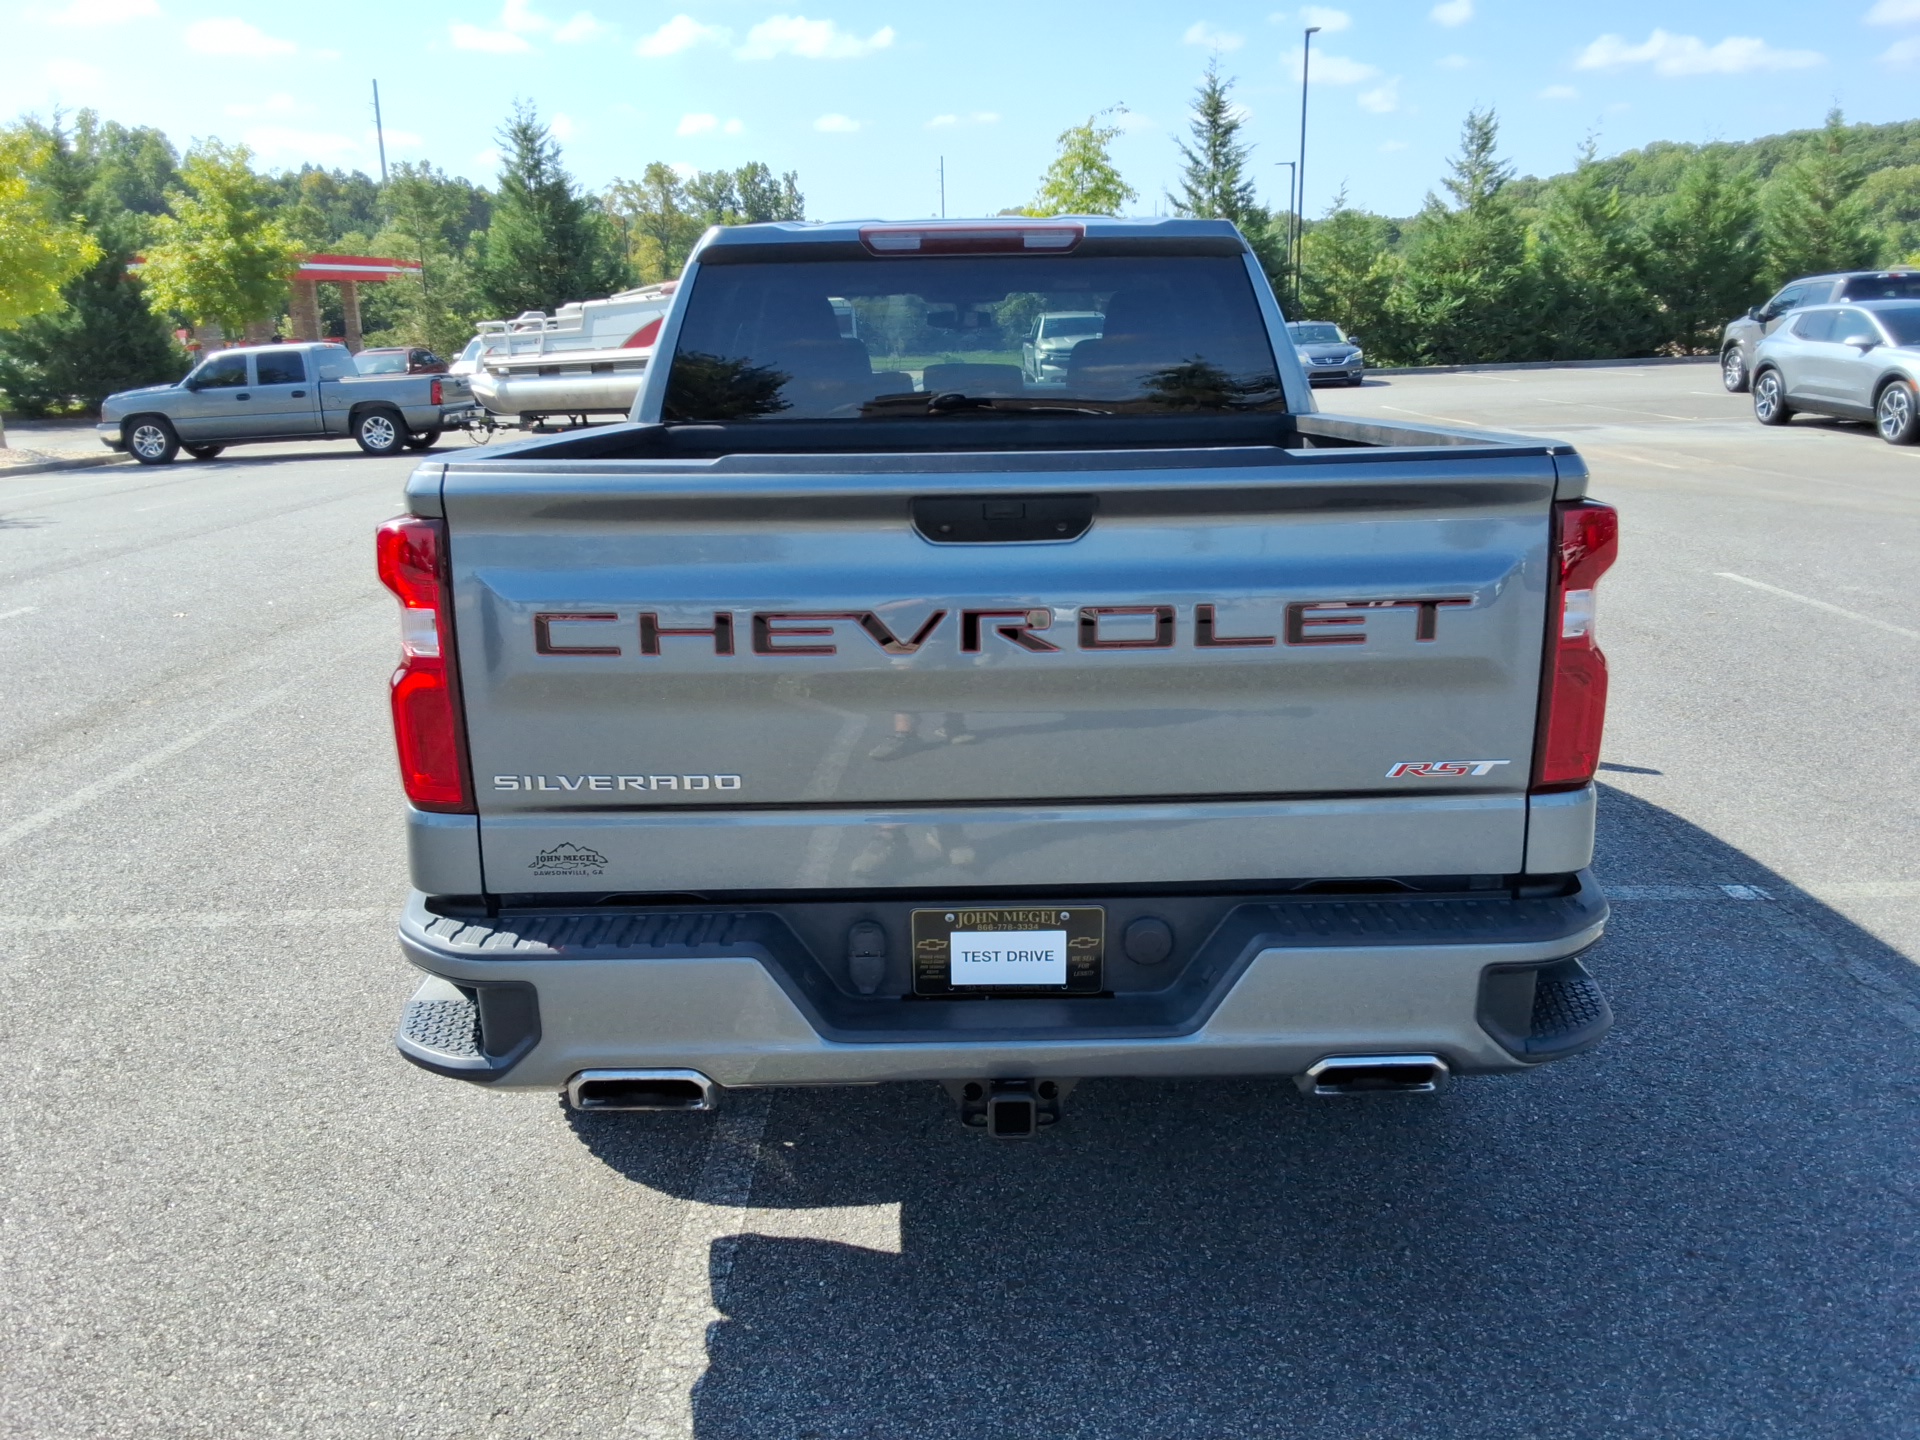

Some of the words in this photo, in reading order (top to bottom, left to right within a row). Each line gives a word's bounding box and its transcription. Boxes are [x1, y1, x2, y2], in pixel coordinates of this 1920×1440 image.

[533, 596, 1473, 656] CHEVROLET
[1385, 760, 1511, 777] RST
[493, 774, 742, 791] SILVERADO
[535, 855, 562, 866] JOHN
[563, 854, 599, 862] MEGEL
[533, 869, 590, 877] DAWSONVILLE,
[956, 911, 999, 929] JOHN
[1003, 910, 1061, 926] MEGEL
[961, 950, 1002, 962] TEST
[1006, 950, 1055, 962] DRIVE
